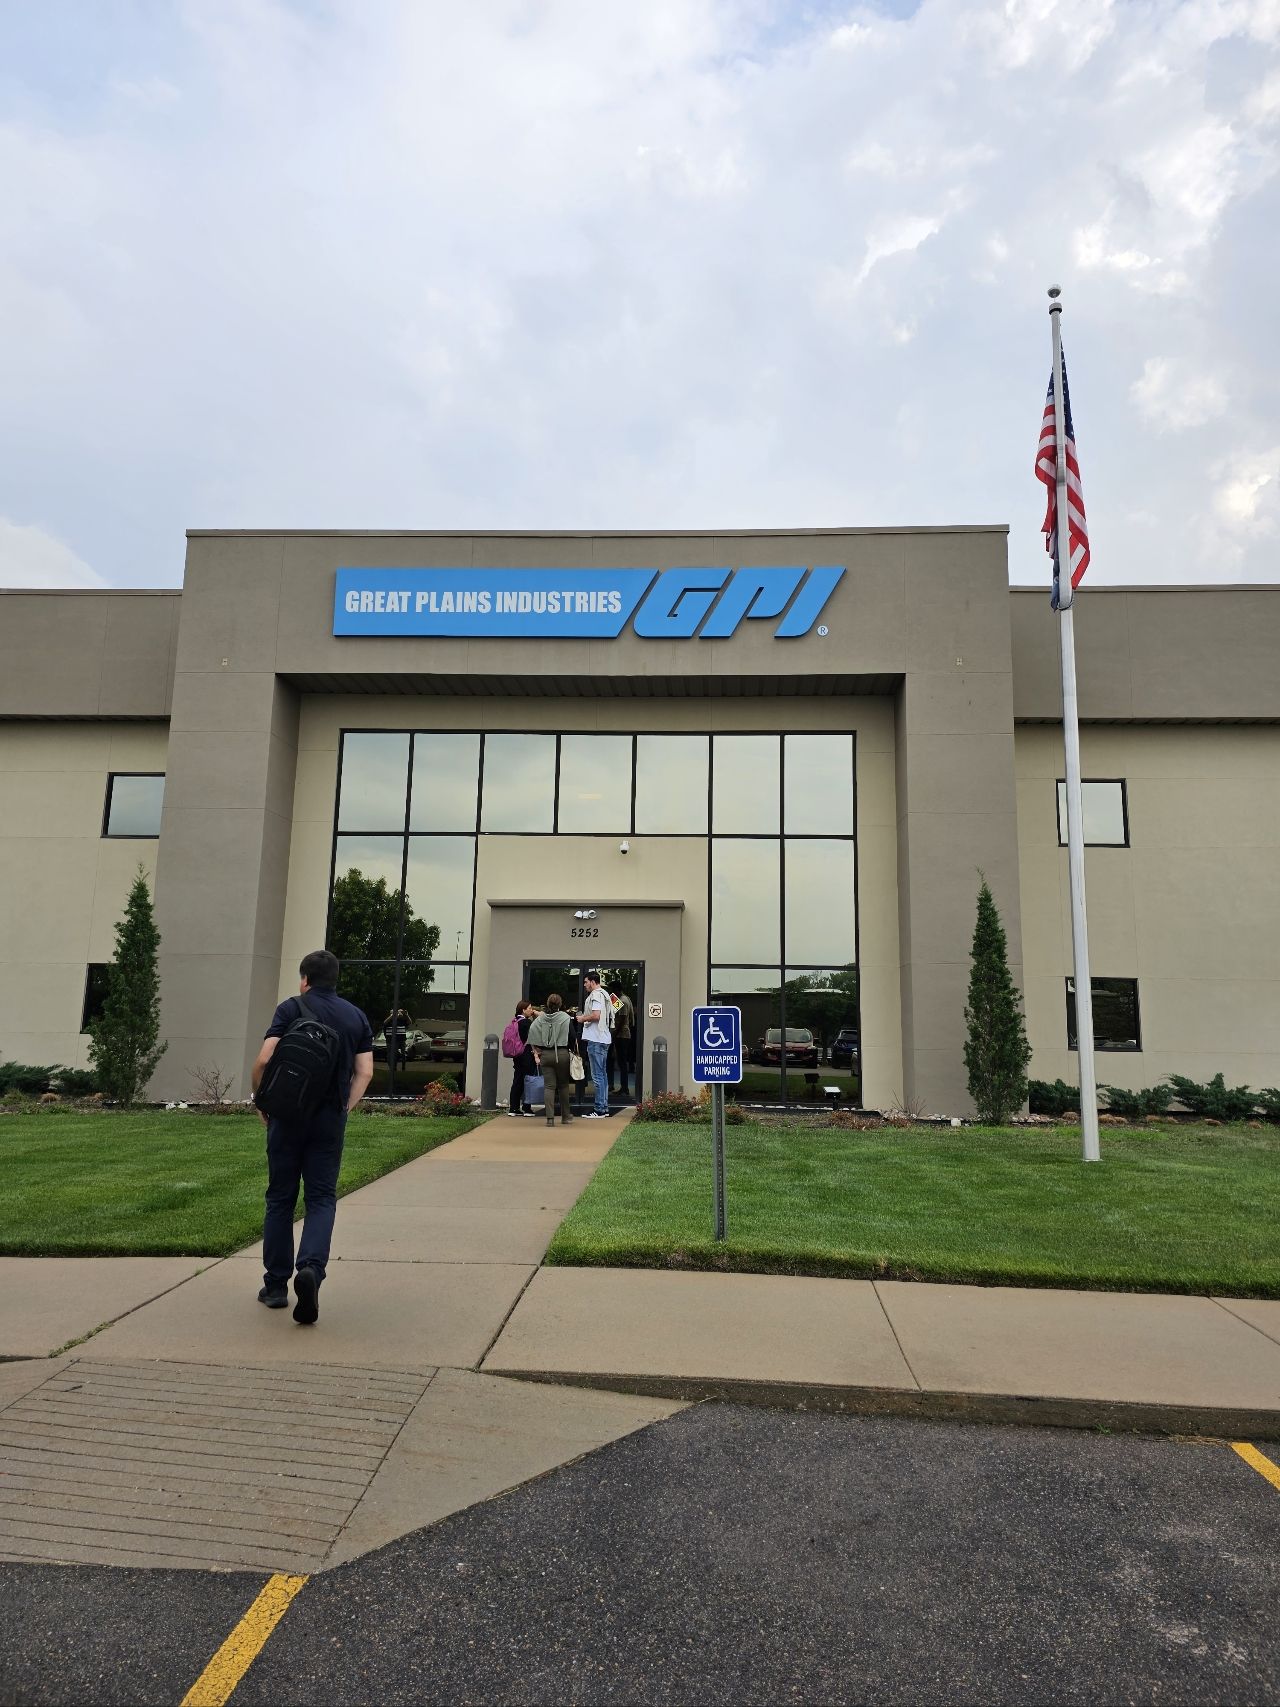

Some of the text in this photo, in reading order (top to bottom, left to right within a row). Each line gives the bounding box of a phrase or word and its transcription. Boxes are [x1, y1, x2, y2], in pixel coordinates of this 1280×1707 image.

[345, 590, 622, 613] GREAT PLAINS INDUSTRIES
[633, 567, 847, 639] GPI
[571, 927, 599, 938] 5252
[696, 1055, 738, 1065] HANDICAPPED
[704, 1066, 731, 1076] PARKING
